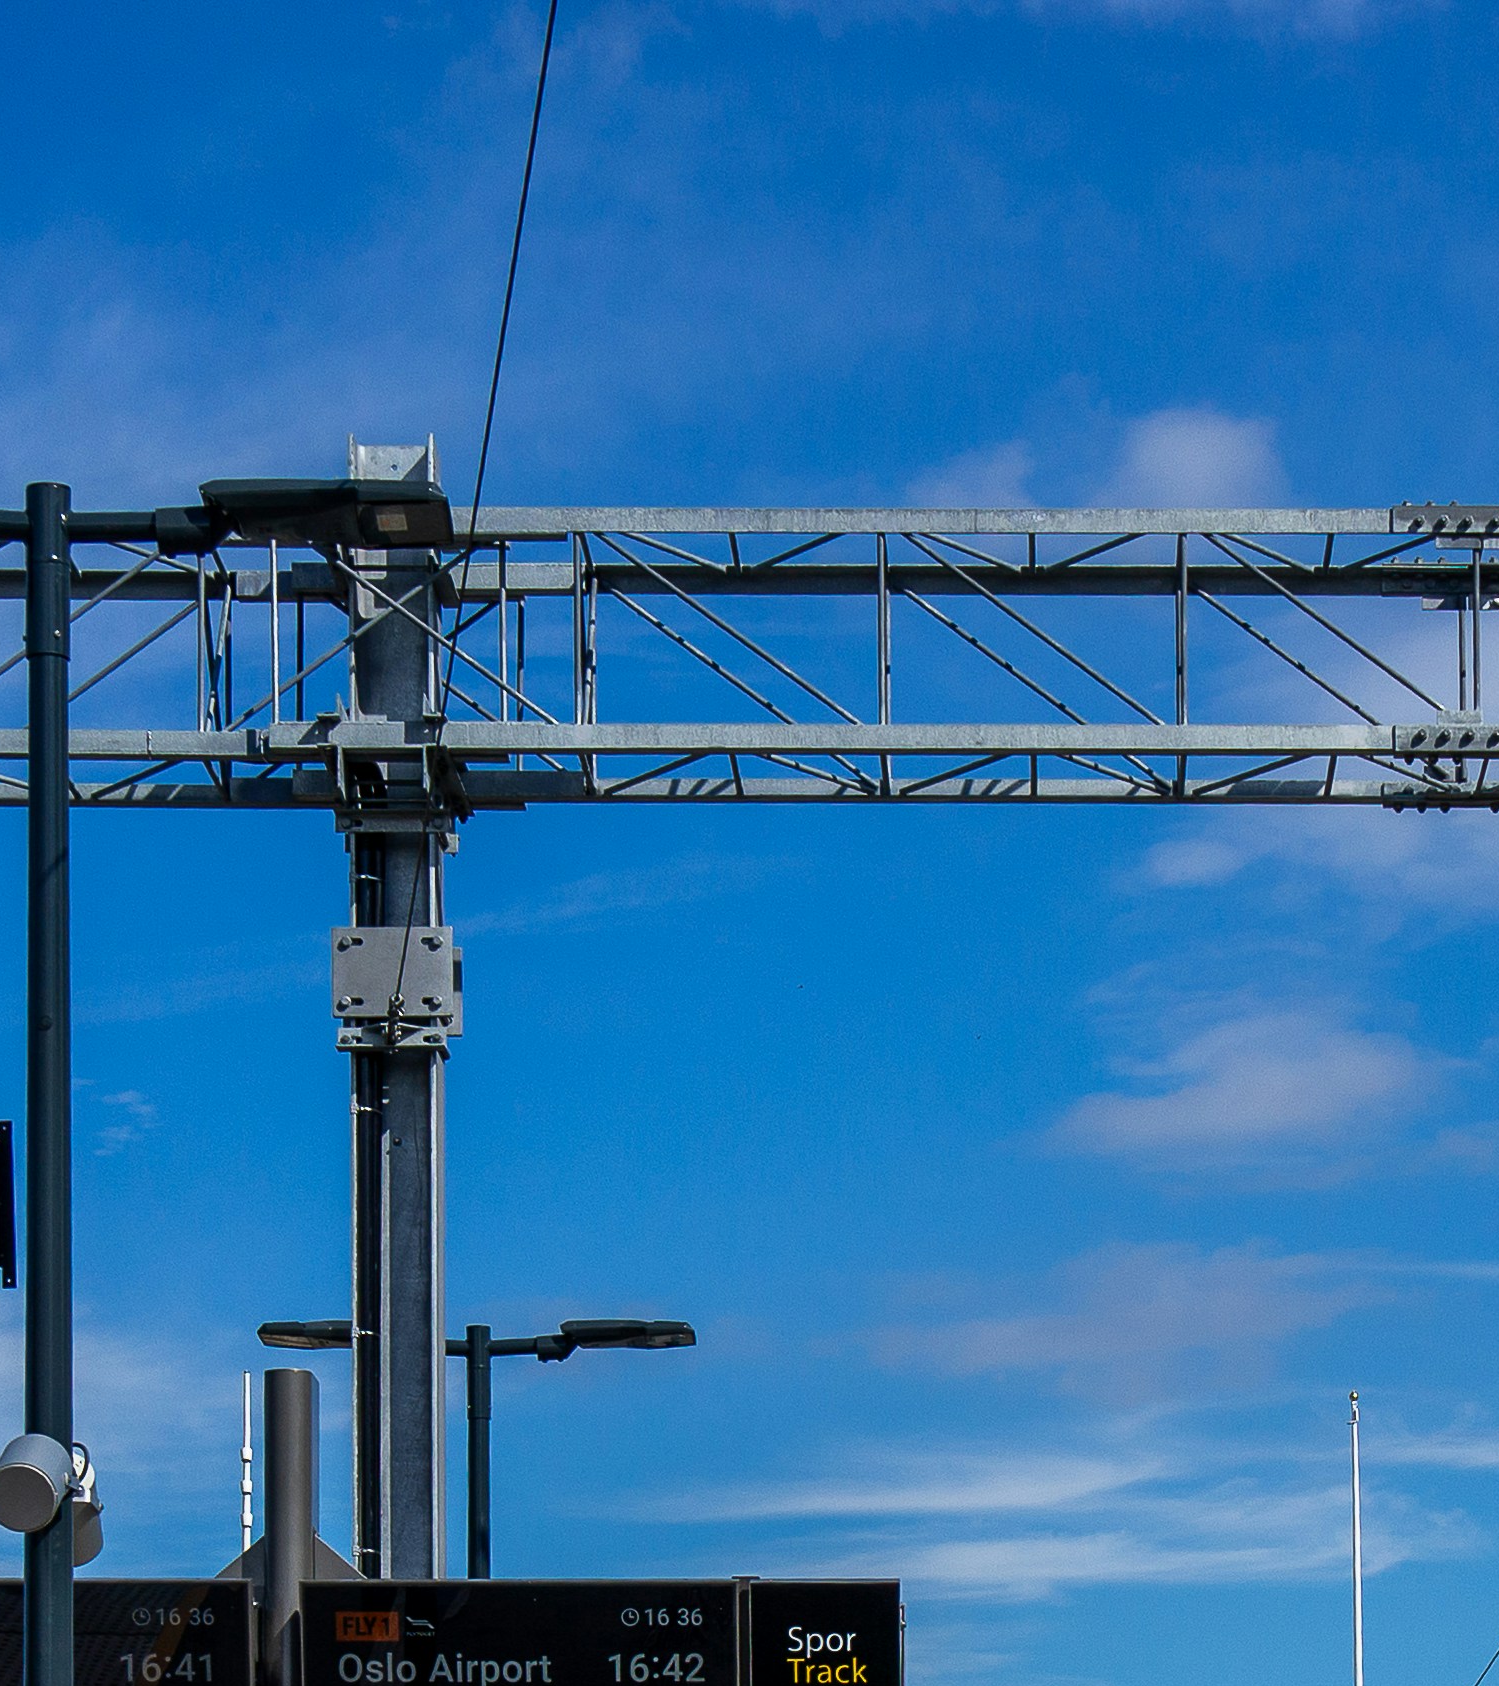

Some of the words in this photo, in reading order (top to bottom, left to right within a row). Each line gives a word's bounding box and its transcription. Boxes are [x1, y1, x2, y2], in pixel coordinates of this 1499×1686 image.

[155, 1607, 182, 1626] 16
[188, 1607, 215, 1626] 36
[342, 1616, 377, 1636] FLY
[381, 1616, 391, 1636] 1
[644, 1607, 670, 1627] 16
[676, 1607, 703, 1627] 36
[787, 1626, 857, 1658] Spor
[119, 1653, 213, 1683] 16:41
[338, 1651, 417, 1684] Oslo
[608, 1653, 706, 1683] 16:42
[787, 1657, 868, 1684] Track
